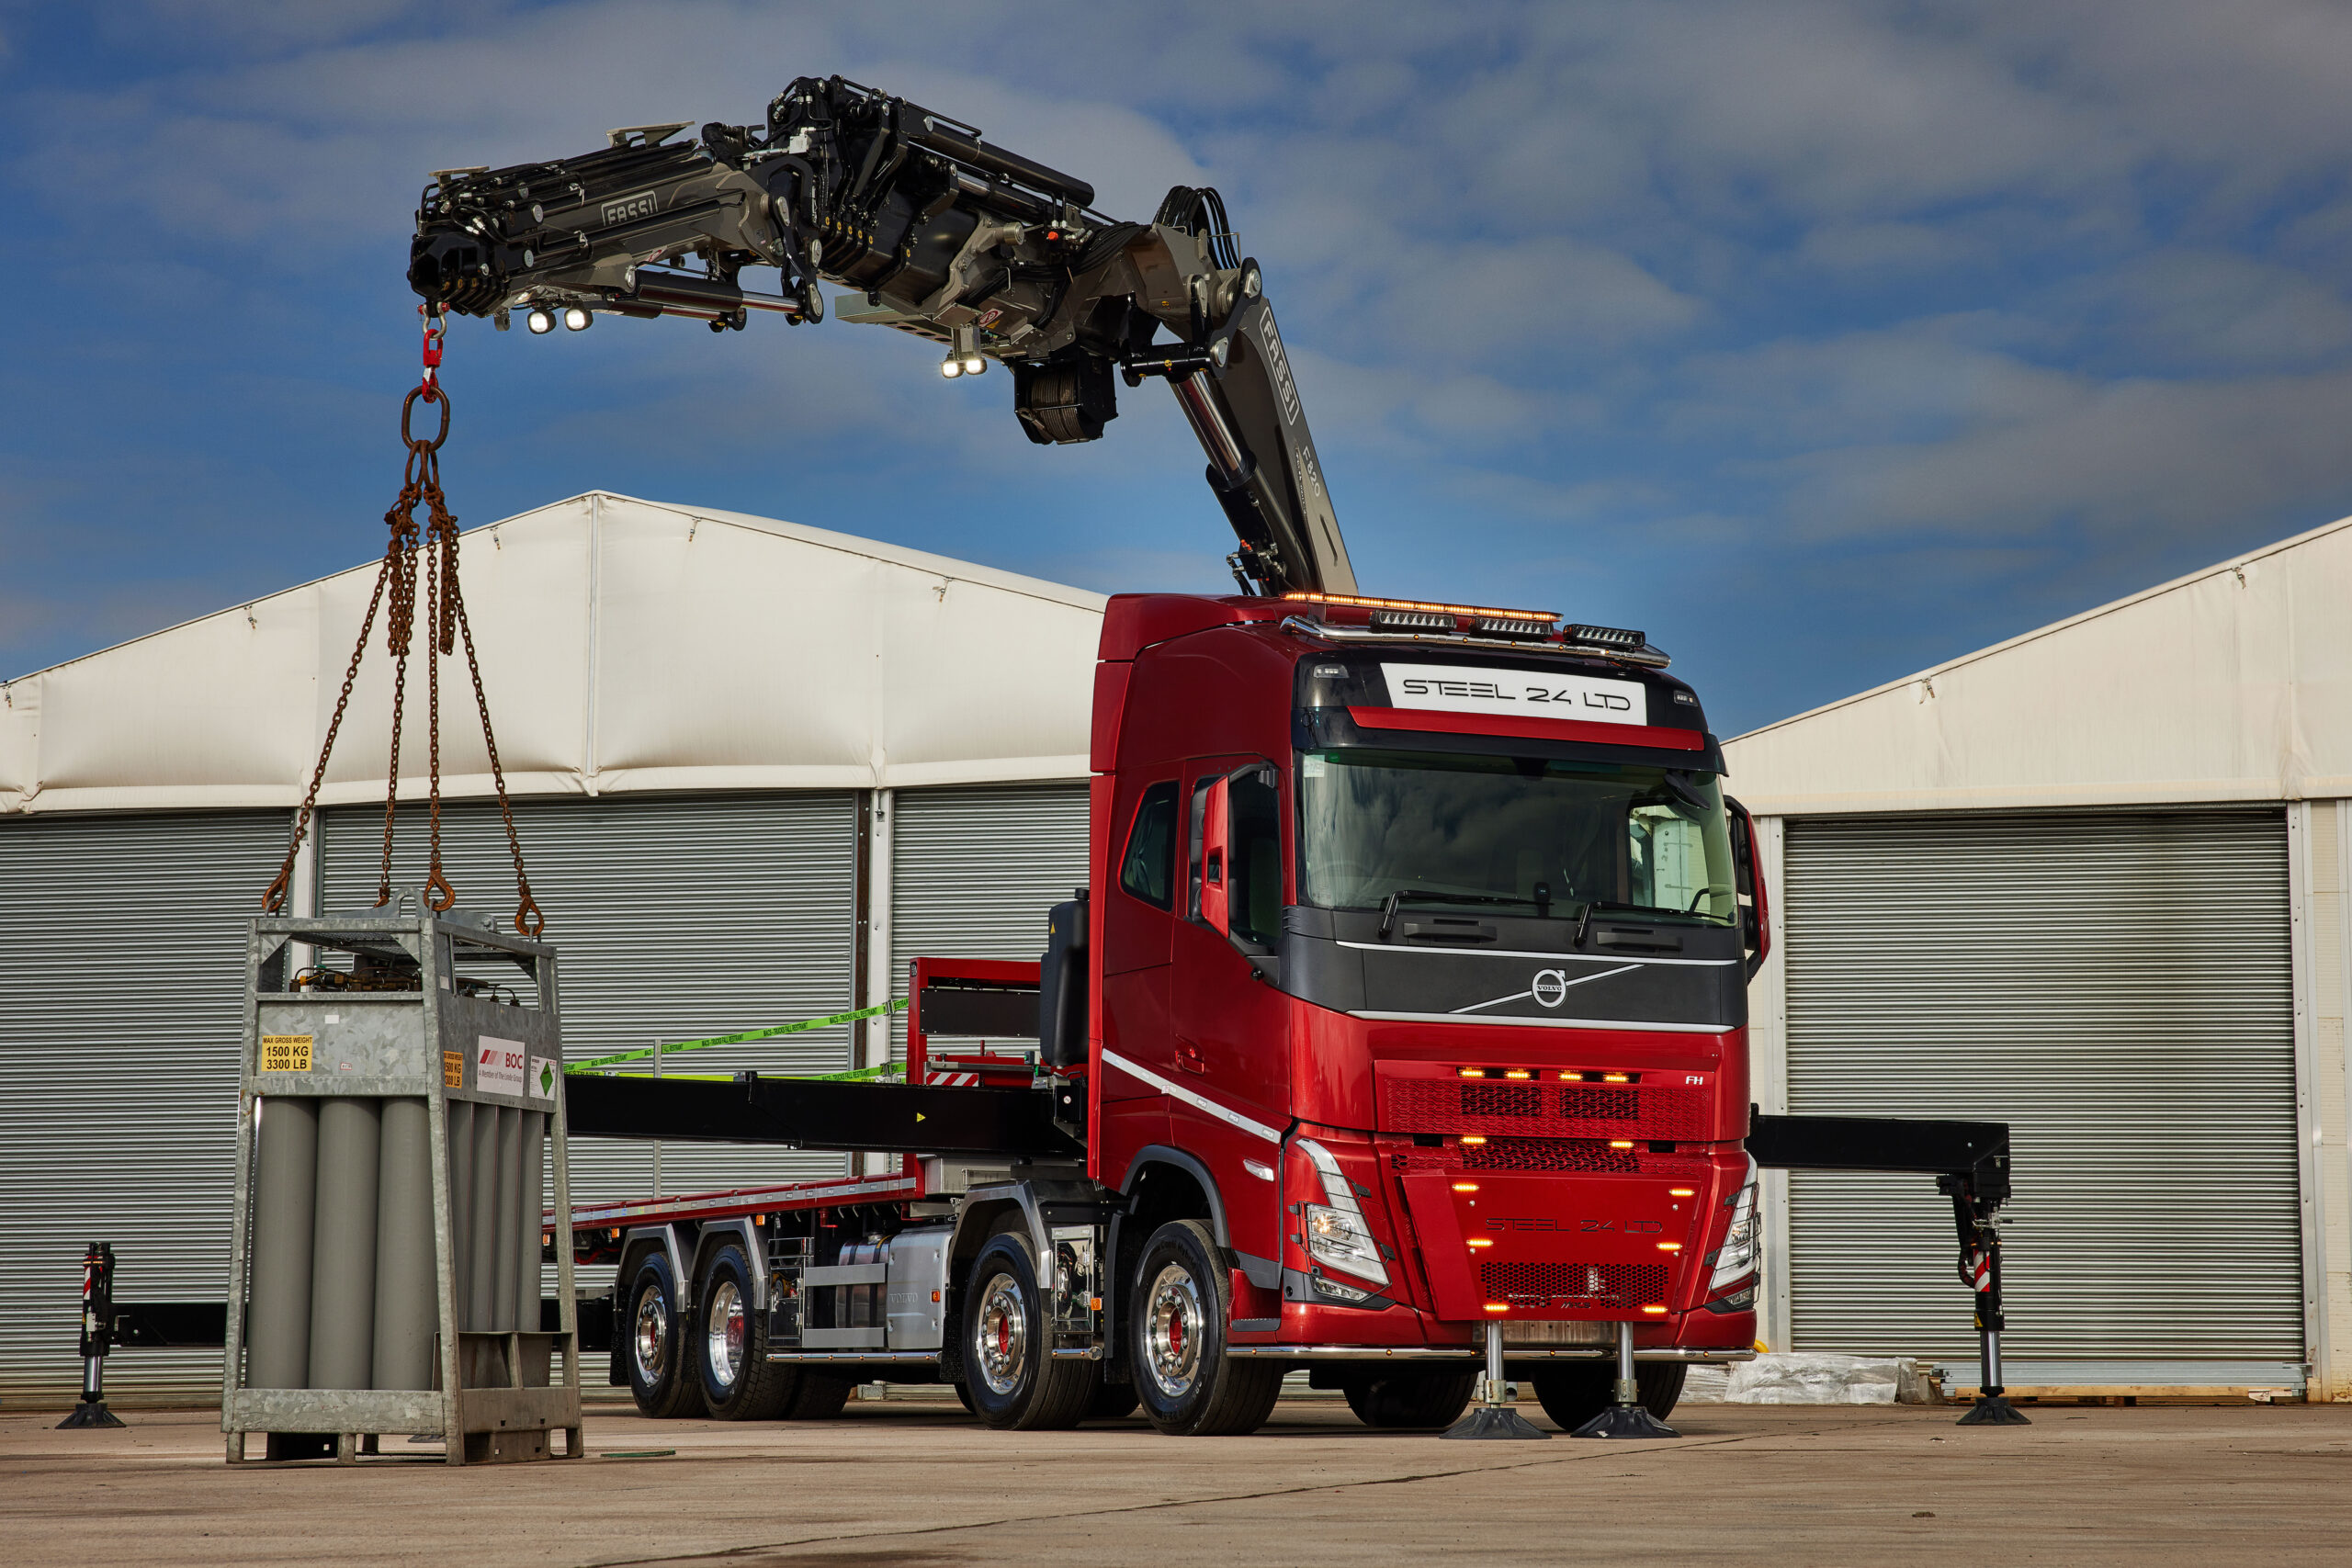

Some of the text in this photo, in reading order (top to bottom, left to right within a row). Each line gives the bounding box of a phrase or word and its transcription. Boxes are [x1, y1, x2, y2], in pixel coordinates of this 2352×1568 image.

[607, 198, 653, 224] FASSI
[1263, 320, 1295, 413] FASSI
[1303, 446, 1320, 498] F820
[1403, 679, 1631, 711] STEEL 24 LTD
[266, 1046, 309, 1056] 1500 KG
[266, 1059, 307, 1069] 3300 LB
[506, 1053, 523, 1069] BOC
[454, 1064, 461, 1074] KG
[454, 1076, 460, 1086] LB
[482, 1070, 494, 1078] Member
[514, 1075, 522, 1084] Group
[1686, 1076, 1703, 1085] FH
[1486, 1218, 1663, 1234] STEEL 24 LTD
